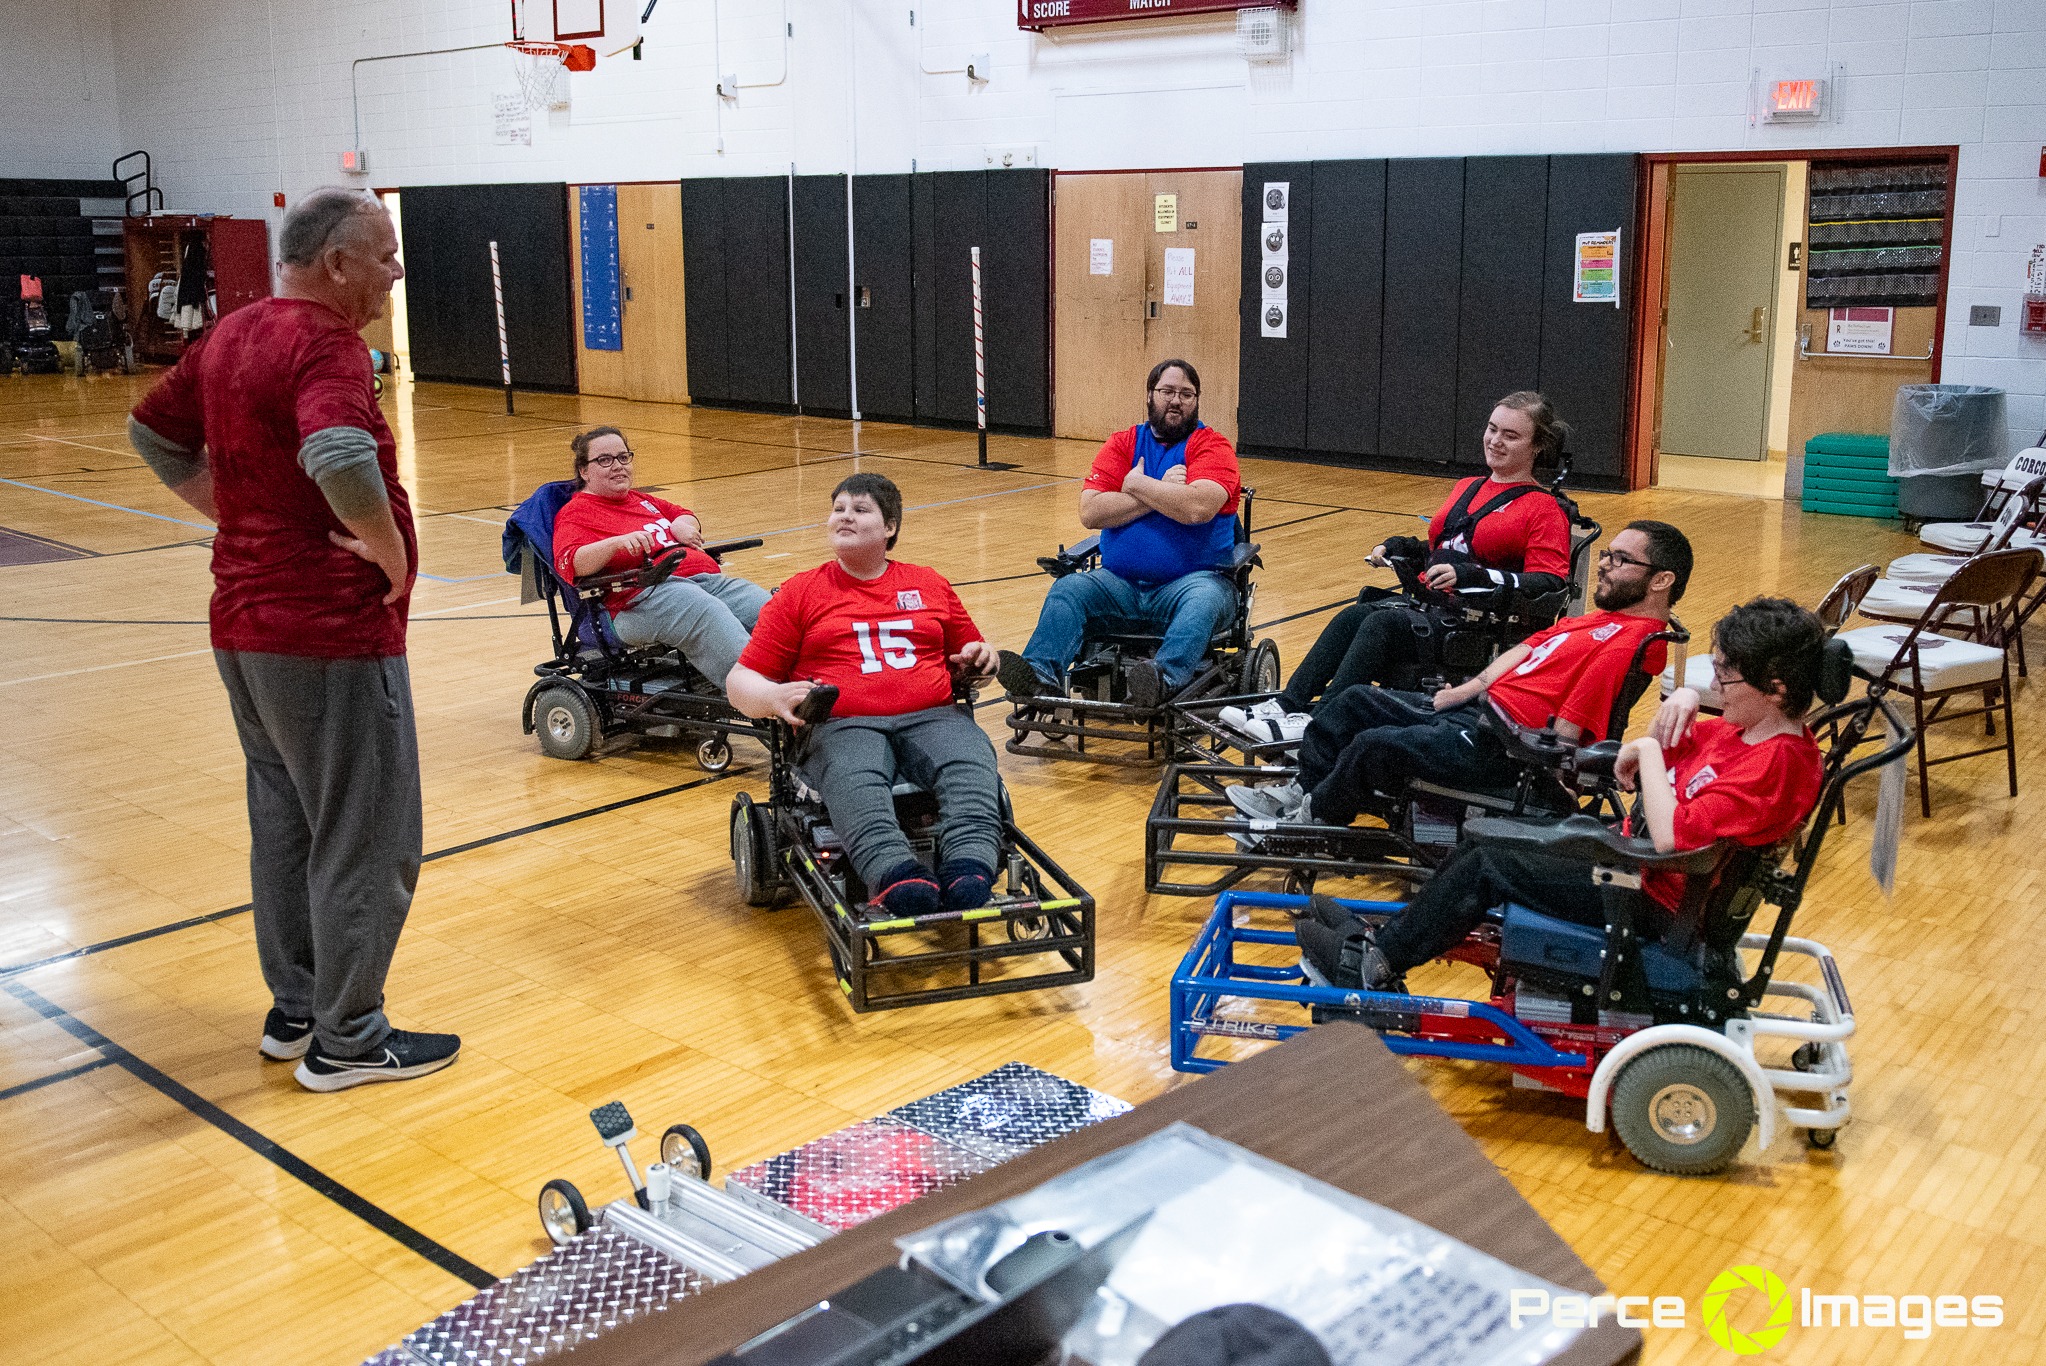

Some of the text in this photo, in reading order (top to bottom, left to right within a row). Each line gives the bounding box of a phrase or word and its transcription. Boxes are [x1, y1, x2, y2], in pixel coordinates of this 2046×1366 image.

[1033, 1, 1070, 18] SCORE
[1777, 80, 1815, 109] EXIT
[1178, 266, 1193, 276] ALL
[2014, 456, 2046, 476] CORCO
[852, 619, 918, 675] 15
[1190, 1016, 1279, 1036] STRIKE
